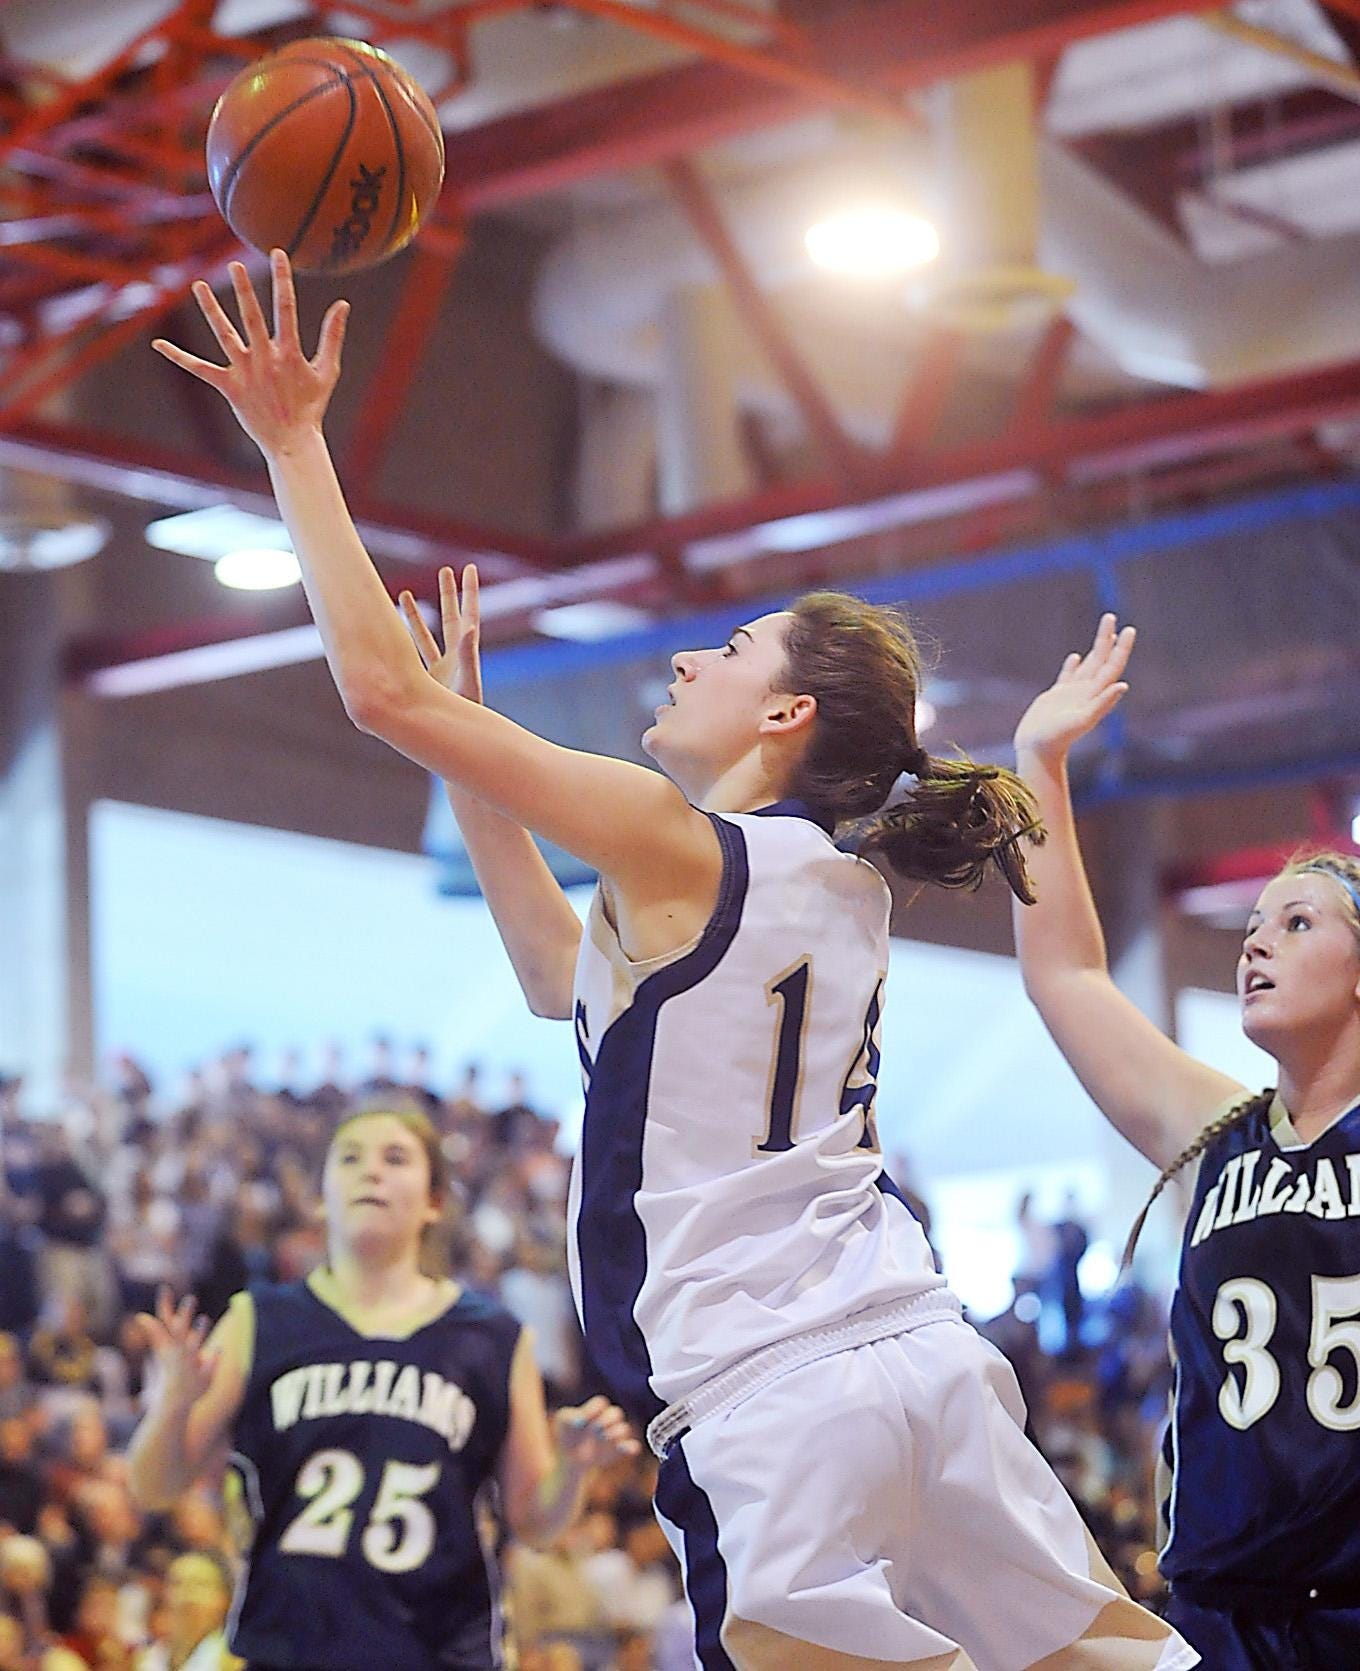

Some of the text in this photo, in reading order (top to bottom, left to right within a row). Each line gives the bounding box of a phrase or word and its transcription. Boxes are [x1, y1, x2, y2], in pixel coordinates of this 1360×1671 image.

[270, 1360, 478, 1452] WILLIAMS
[1211, 1275, 1360, 1431] 35
[278, 1448, 442, 1574] 25
